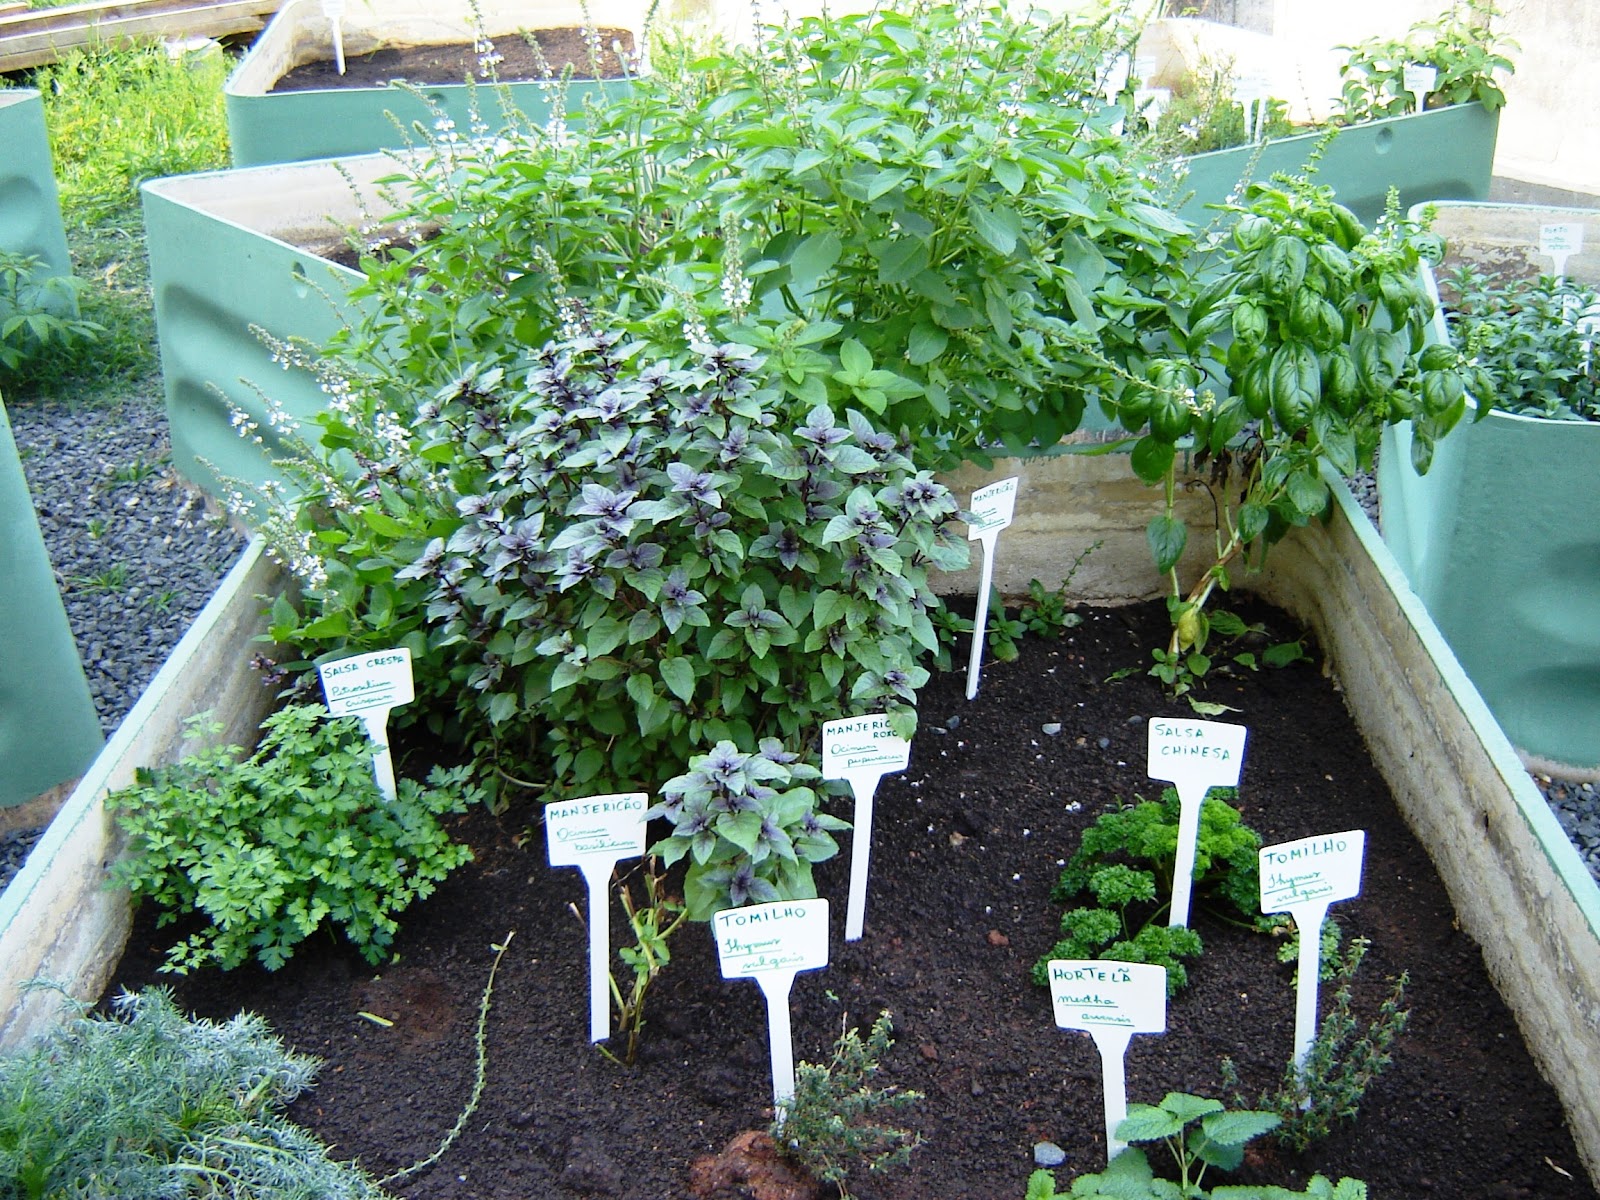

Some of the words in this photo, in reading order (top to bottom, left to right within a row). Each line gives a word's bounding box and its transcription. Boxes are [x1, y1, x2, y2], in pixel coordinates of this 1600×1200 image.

[324, 663, 359, 679] SALSA
[827, 718, 891, 736] MANJERIC
[1154, 723, 1204, 738] SALSA
[1161, 745, 1230, 761] CHINESA
[550, 797, 642, 821] MANJERICÃO
[1053, 967, 1132, 983] HORTELÃ
